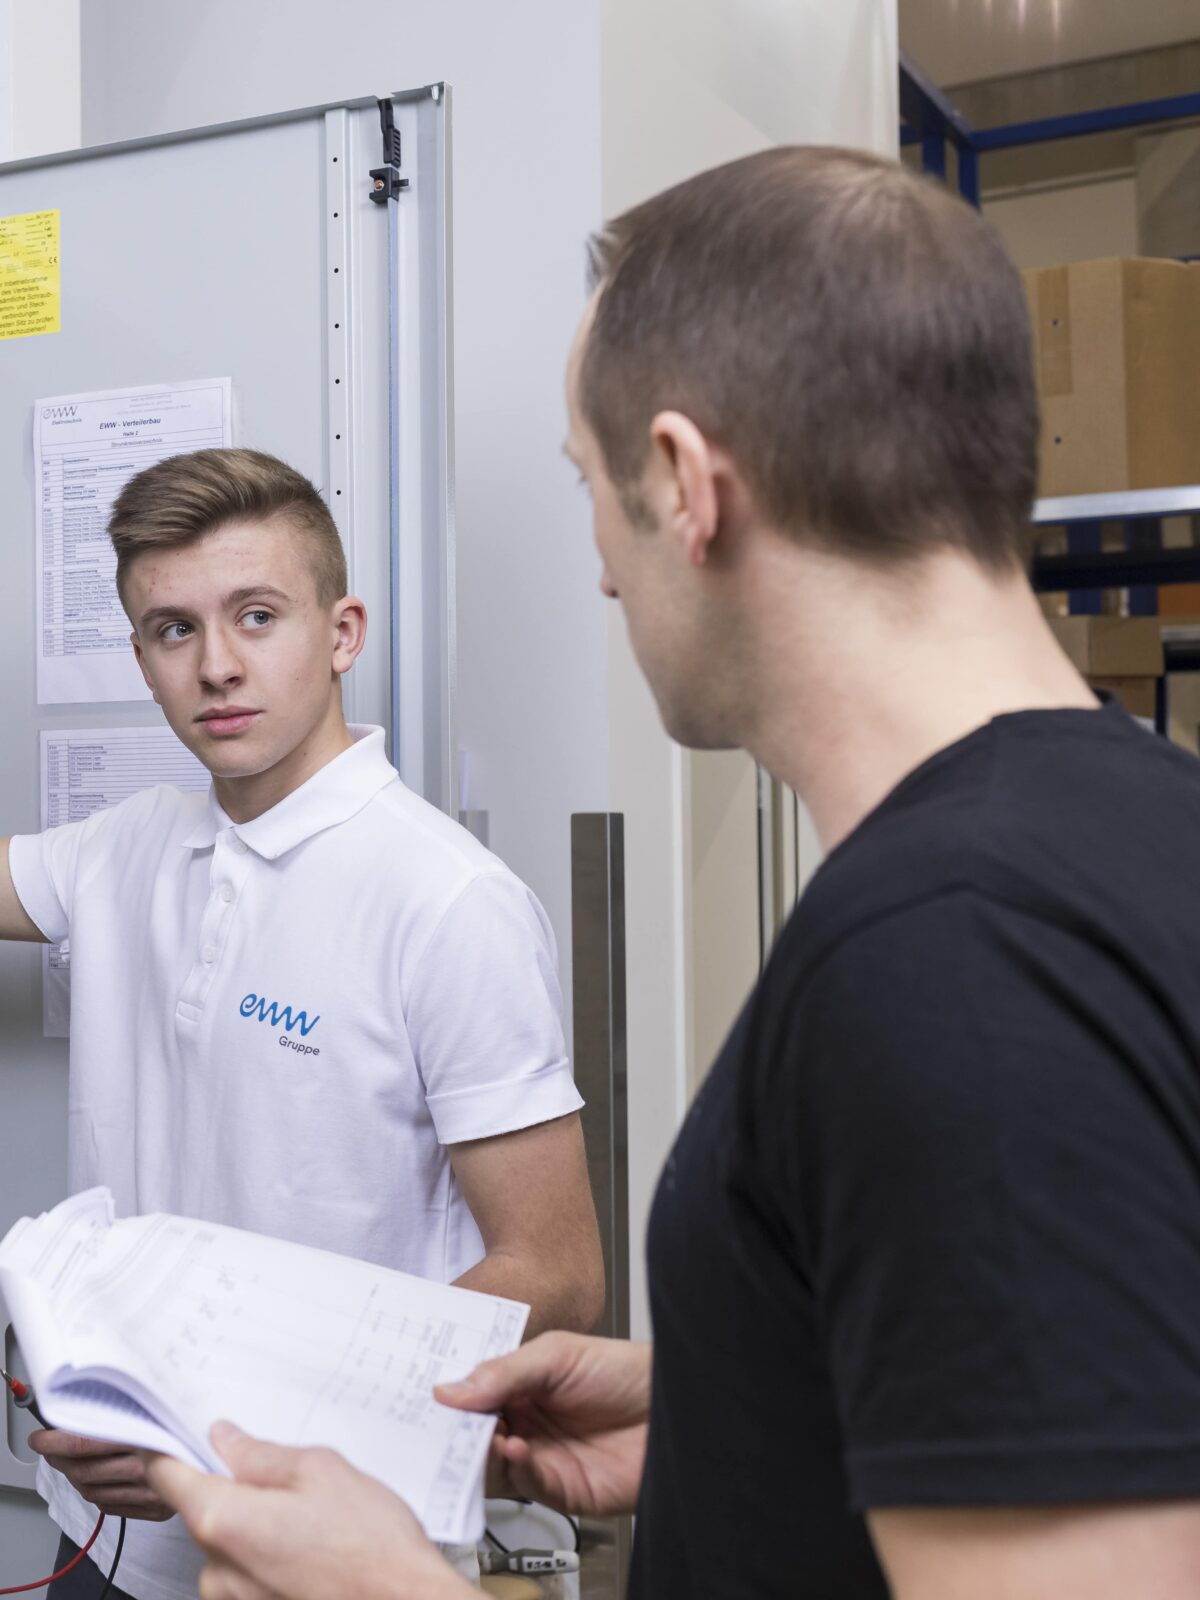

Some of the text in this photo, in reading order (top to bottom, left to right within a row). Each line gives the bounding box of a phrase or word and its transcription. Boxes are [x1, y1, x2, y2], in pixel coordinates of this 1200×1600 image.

[100, 420, 118, 430] EWW
[122, 418, 162, 428] Verteilerbau
[279, 1036, 320, 1056] Gruppe
